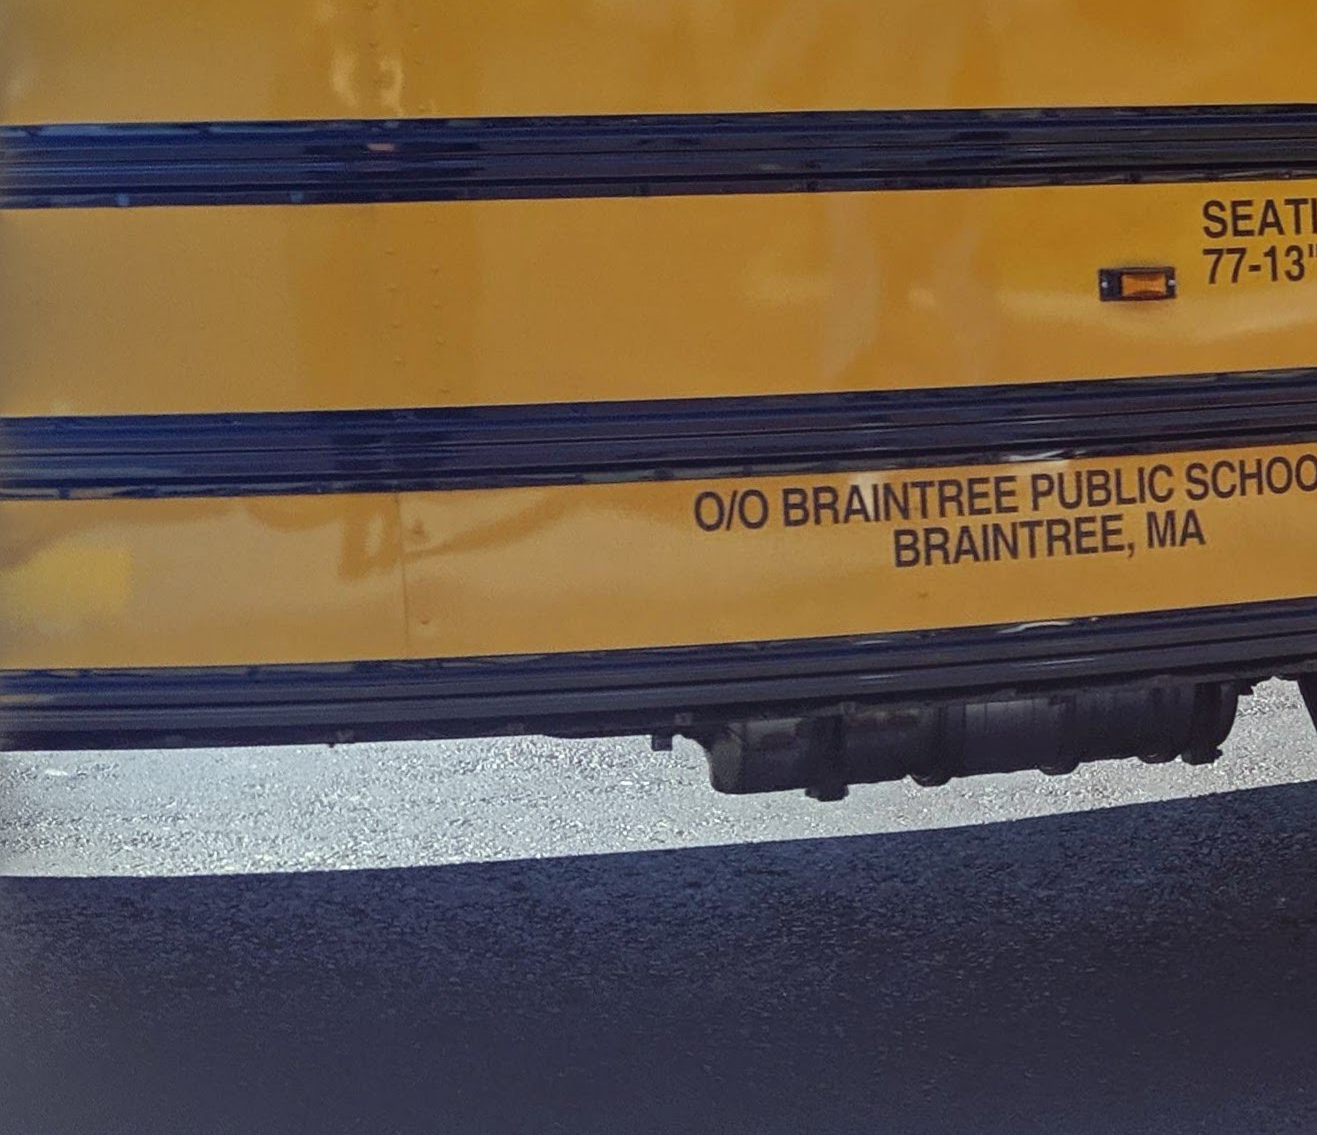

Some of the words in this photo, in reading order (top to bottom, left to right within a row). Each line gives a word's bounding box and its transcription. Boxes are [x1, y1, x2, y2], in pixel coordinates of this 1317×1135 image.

[694, 489, 769, 532] O/O
[781, 475, 1018, 527] BRAINTREE
[1030, 464, 1174, 512] PUBLIC
[893, 514, 1136, 568] BRAINTREE,
[1146, 509, 1206, 548] MA
